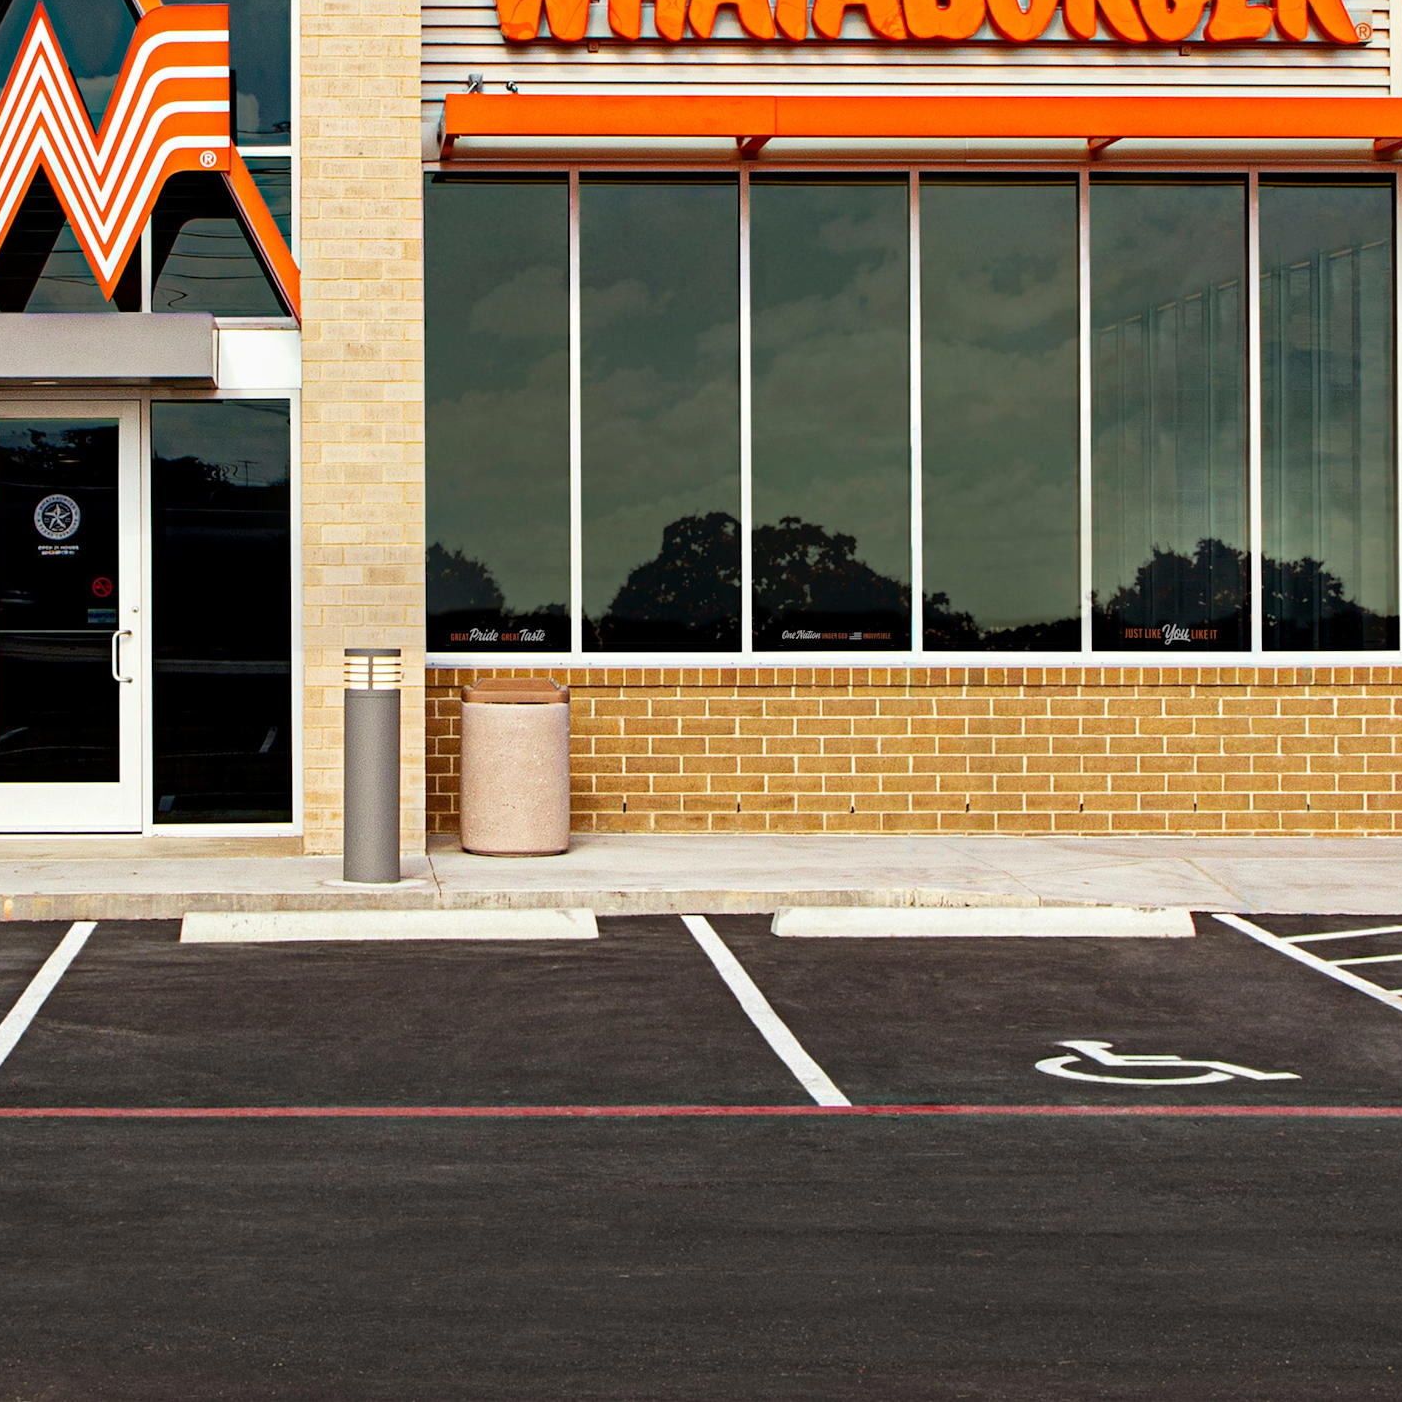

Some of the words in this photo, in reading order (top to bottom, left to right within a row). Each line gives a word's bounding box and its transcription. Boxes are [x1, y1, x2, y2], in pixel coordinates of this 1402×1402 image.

[450, 633, 469, 641] GREAT
[469, 628, 499, 642] Pride
[501, 633, 520, 641] GREAT
[519, 628, 545, 642] Taste
[782, 630, 796, 639] One
[796, 630, 821, 640] Nation
[1125, 628, 1143, 638] JUST
[1144, 628, 1161, 639] LIKE
[1162, 623, 1191, 645] You
[1191, 629, 1208, 639] LIKE
[1209, 629, 1218, 640] IT
